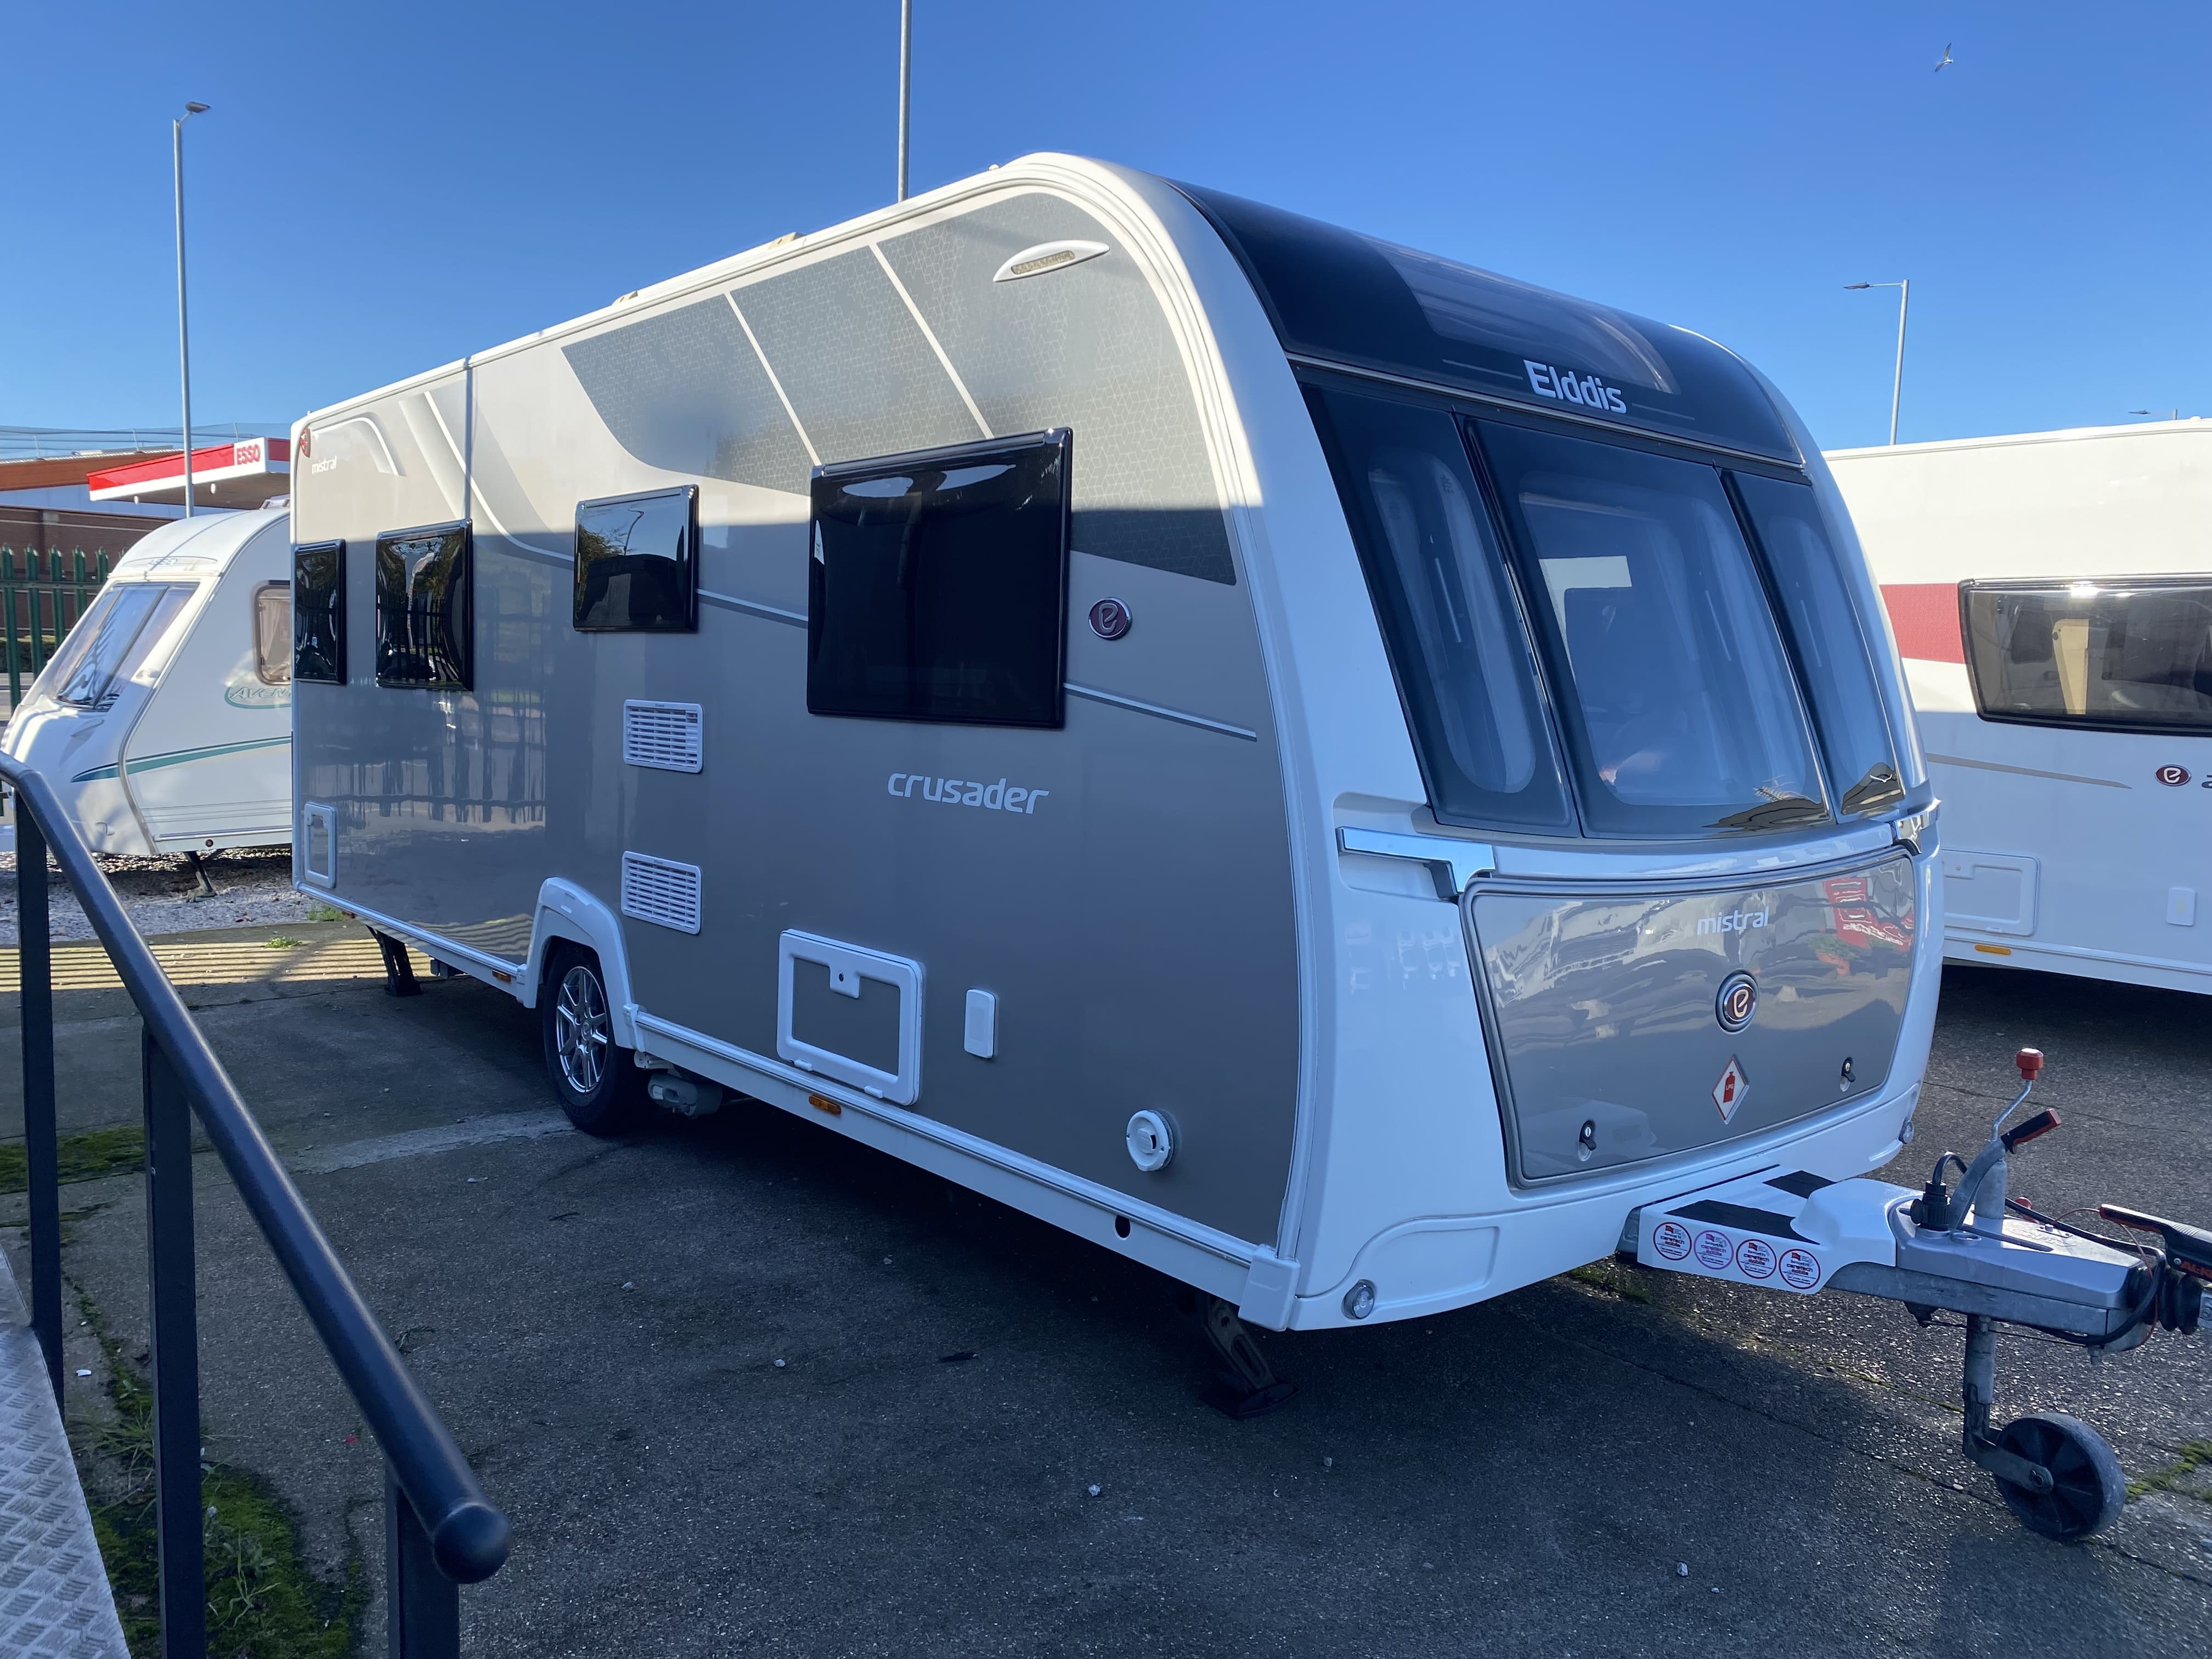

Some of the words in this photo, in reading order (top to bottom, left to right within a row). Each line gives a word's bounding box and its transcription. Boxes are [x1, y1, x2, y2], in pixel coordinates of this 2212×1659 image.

[1523, 359, 1627, 414] Elddis
[236, 444, 261, 465] ESSO
[312, 455, 337, 474] mistral
[229, 686, 291, 698] AVEN
[887, 773, 1049, 814] crusader
[1697, 906, 1769, 935] mistral
